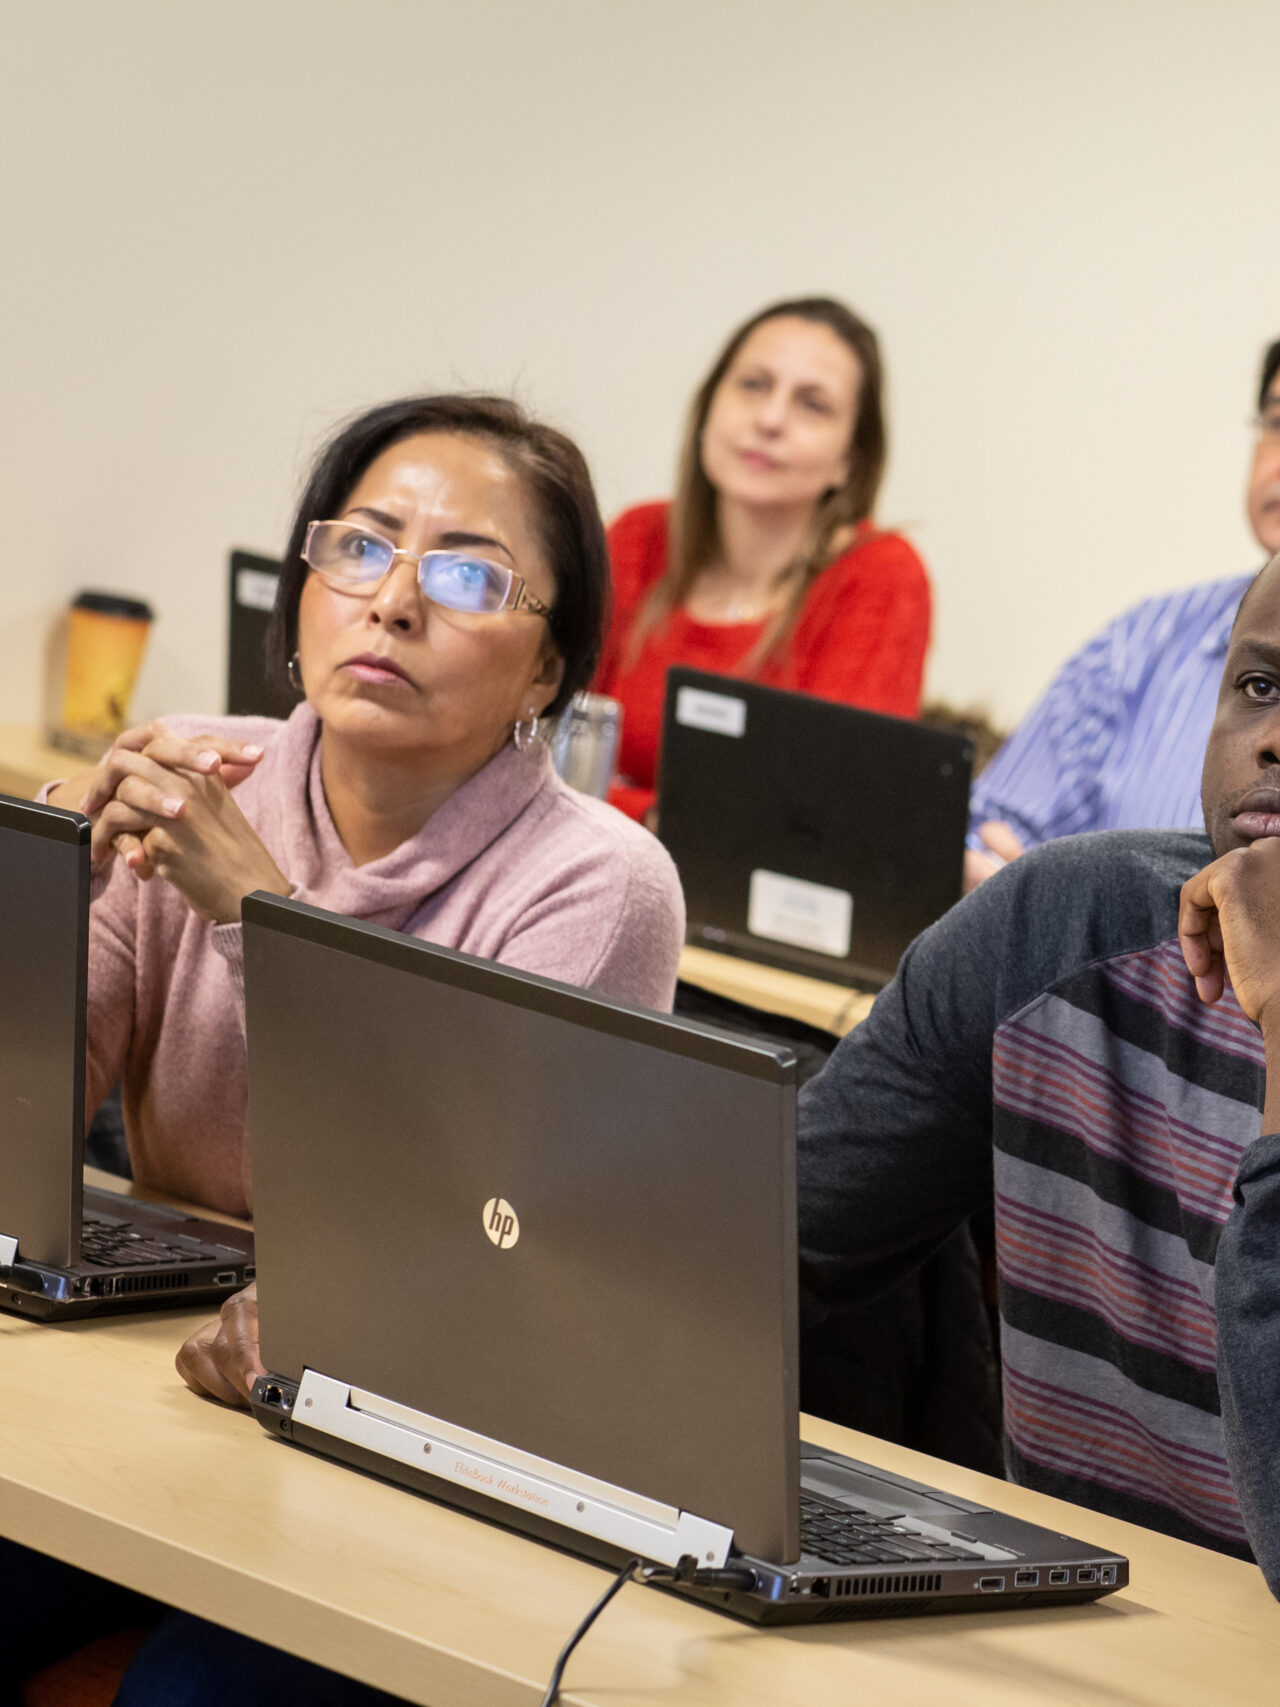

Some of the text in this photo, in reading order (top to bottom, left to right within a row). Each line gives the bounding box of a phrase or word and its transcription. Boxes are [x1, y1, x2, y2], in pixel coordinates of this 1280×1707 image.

[486, 1197, 516, 1249] hp
[454, 1462, 549, 1507] EliteBook Workstation
